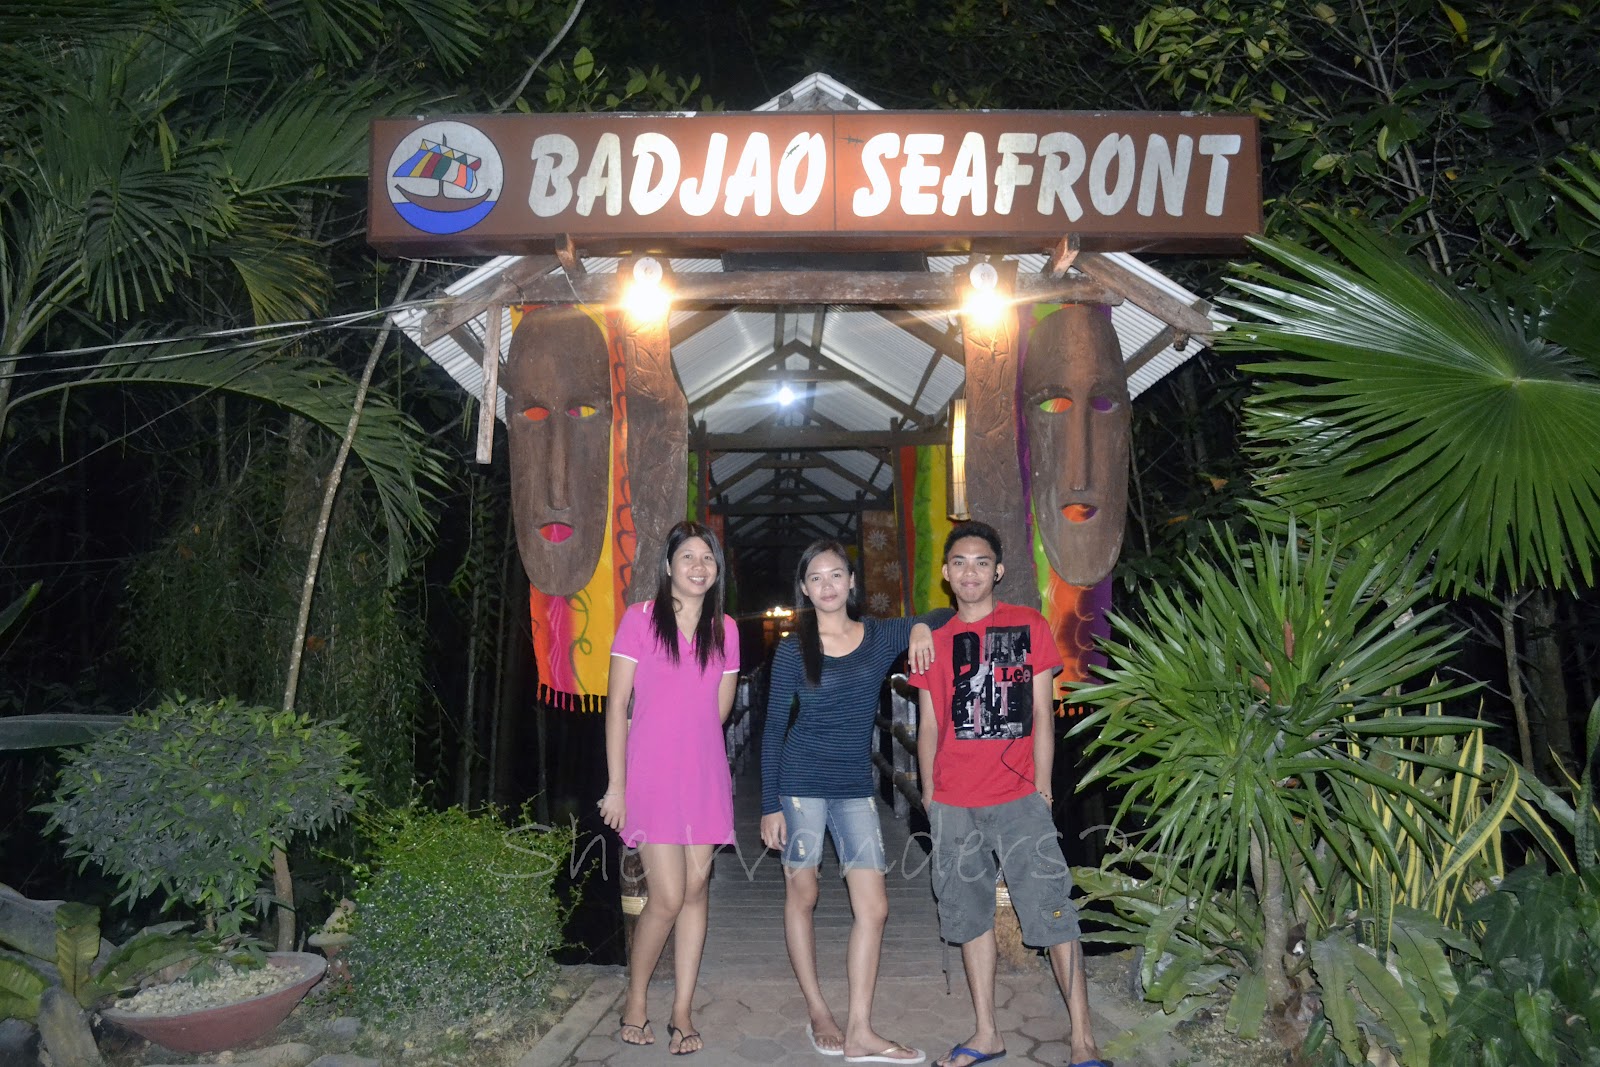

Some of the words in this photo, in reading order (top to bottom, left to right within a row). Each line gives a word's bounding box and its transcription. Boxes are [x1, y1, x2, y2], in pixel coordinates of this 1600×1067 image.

[528, 131, 827, 218] BADJAO
[852, 131, 1241, 222] SEAFRONT
[1001, 667, 1031, 682] Lee
